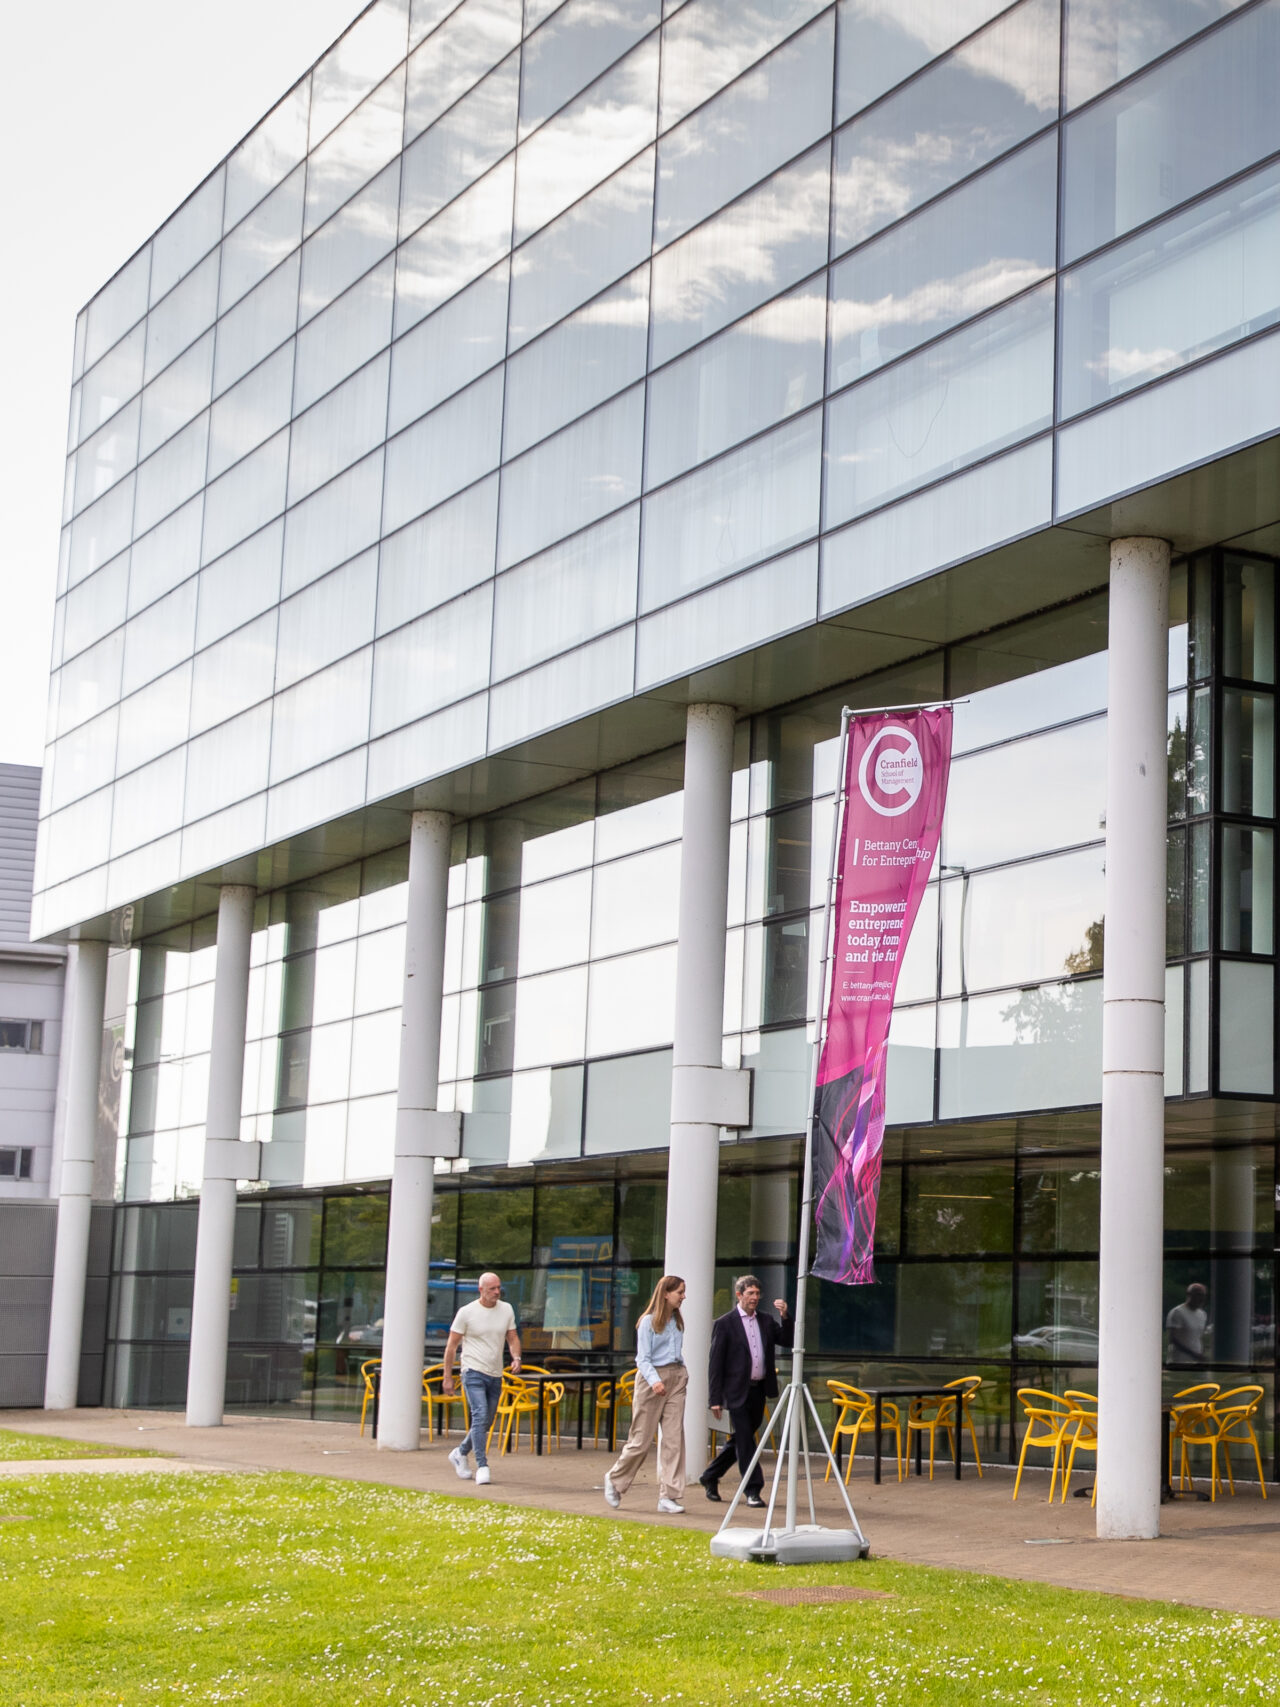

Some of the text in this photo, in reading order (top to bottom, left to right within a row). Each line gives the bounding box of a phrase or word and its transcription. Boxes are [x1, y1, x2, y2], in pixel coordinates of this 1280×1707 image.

[880, 757, 918, 770] Cranfield
[864, 839, 901, 853] Bettany
[862, 854, 878, 866] for
[845, 949, 869, 962] and
